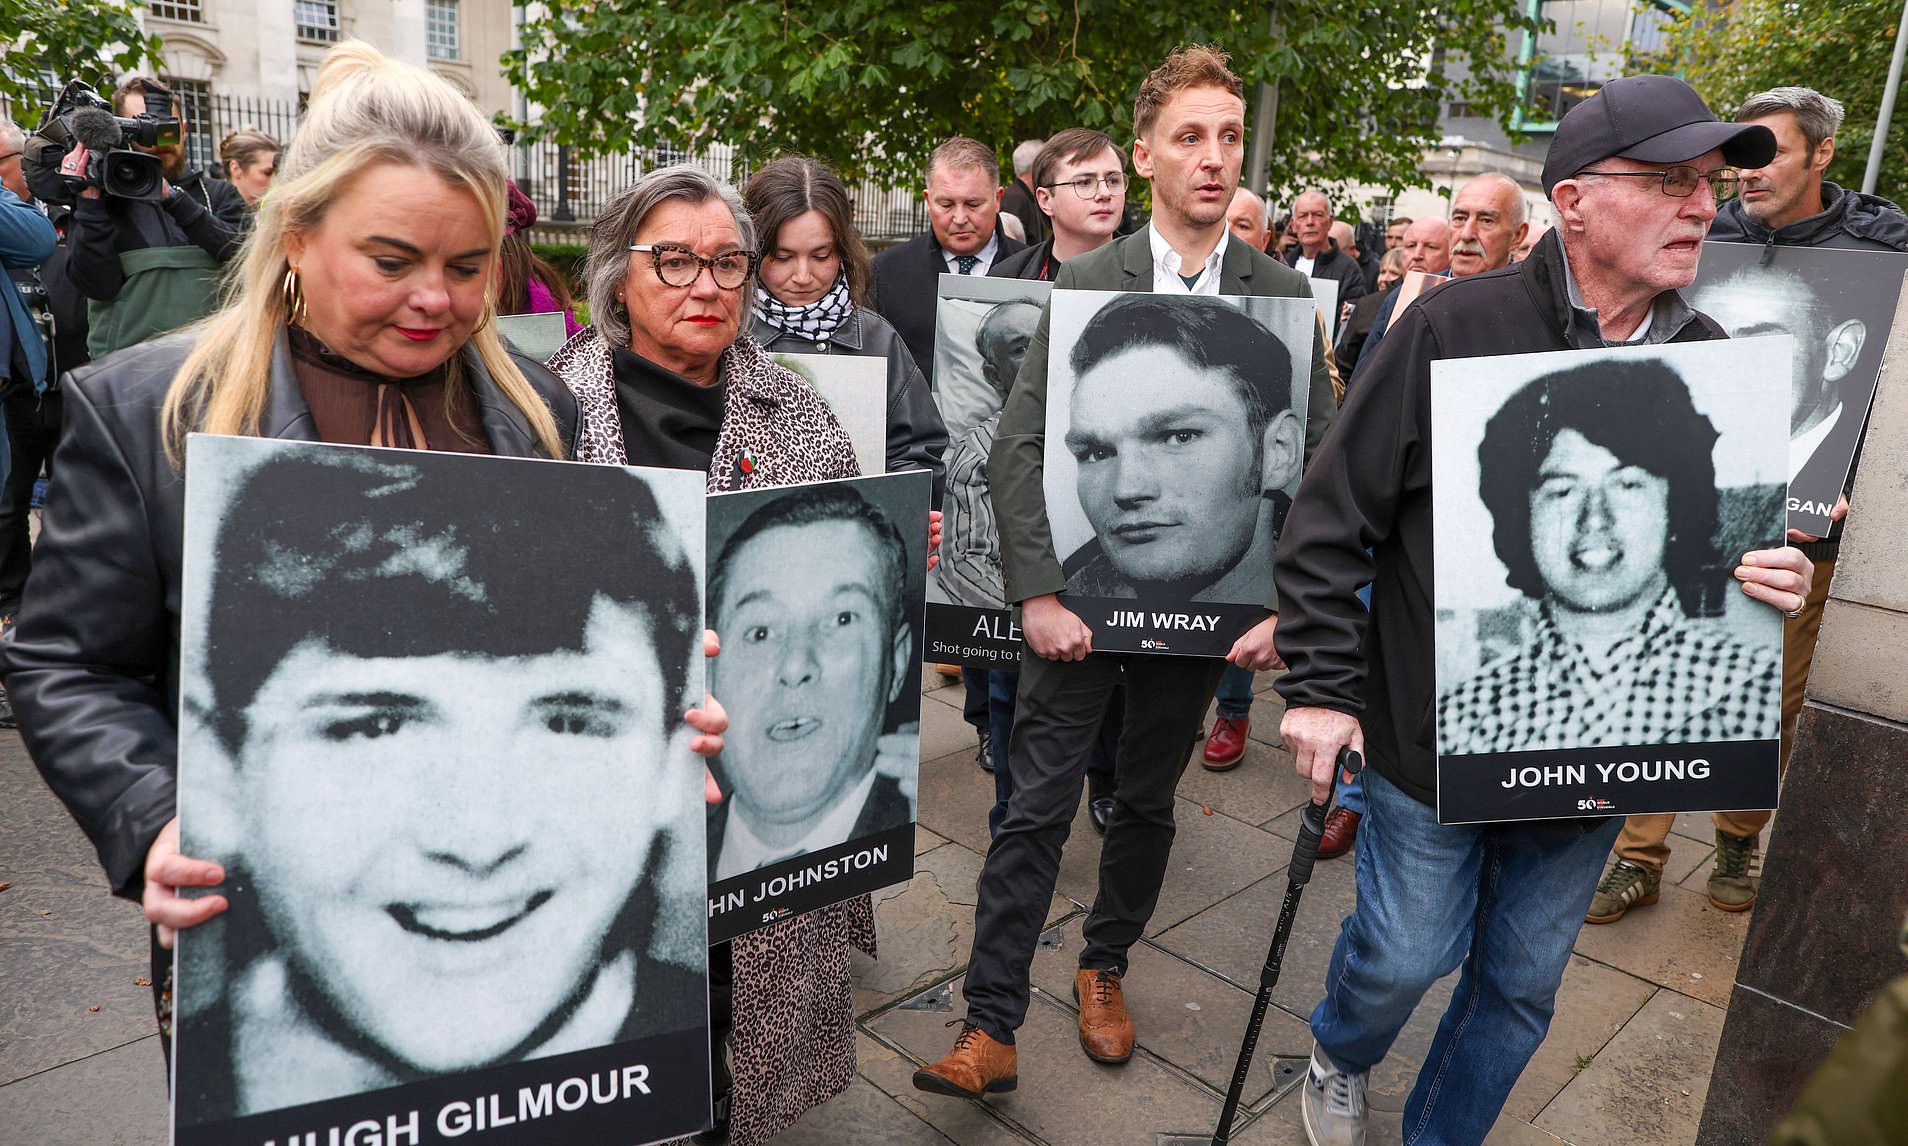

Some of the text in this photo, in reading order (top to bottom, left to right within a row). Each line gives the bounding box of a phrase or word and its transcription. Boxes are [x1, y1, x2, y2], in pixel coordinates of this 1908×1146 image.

[1787, 498, 1832, 516] GAN
[1106, 611, 1221, 632] JIM WRAY
[932, 641, 960, 655] Shot
[962, 646, 998, 661] going
[1001, 649, 1013, 660] to
[1501, 758, 1711, 789] JOHN YOUNG
[1577, 799, 1597, 810] 50
[753, 844, 889, 902] JOHNSTON
[263, 1063, 652, 1146] GH GILMOUR
